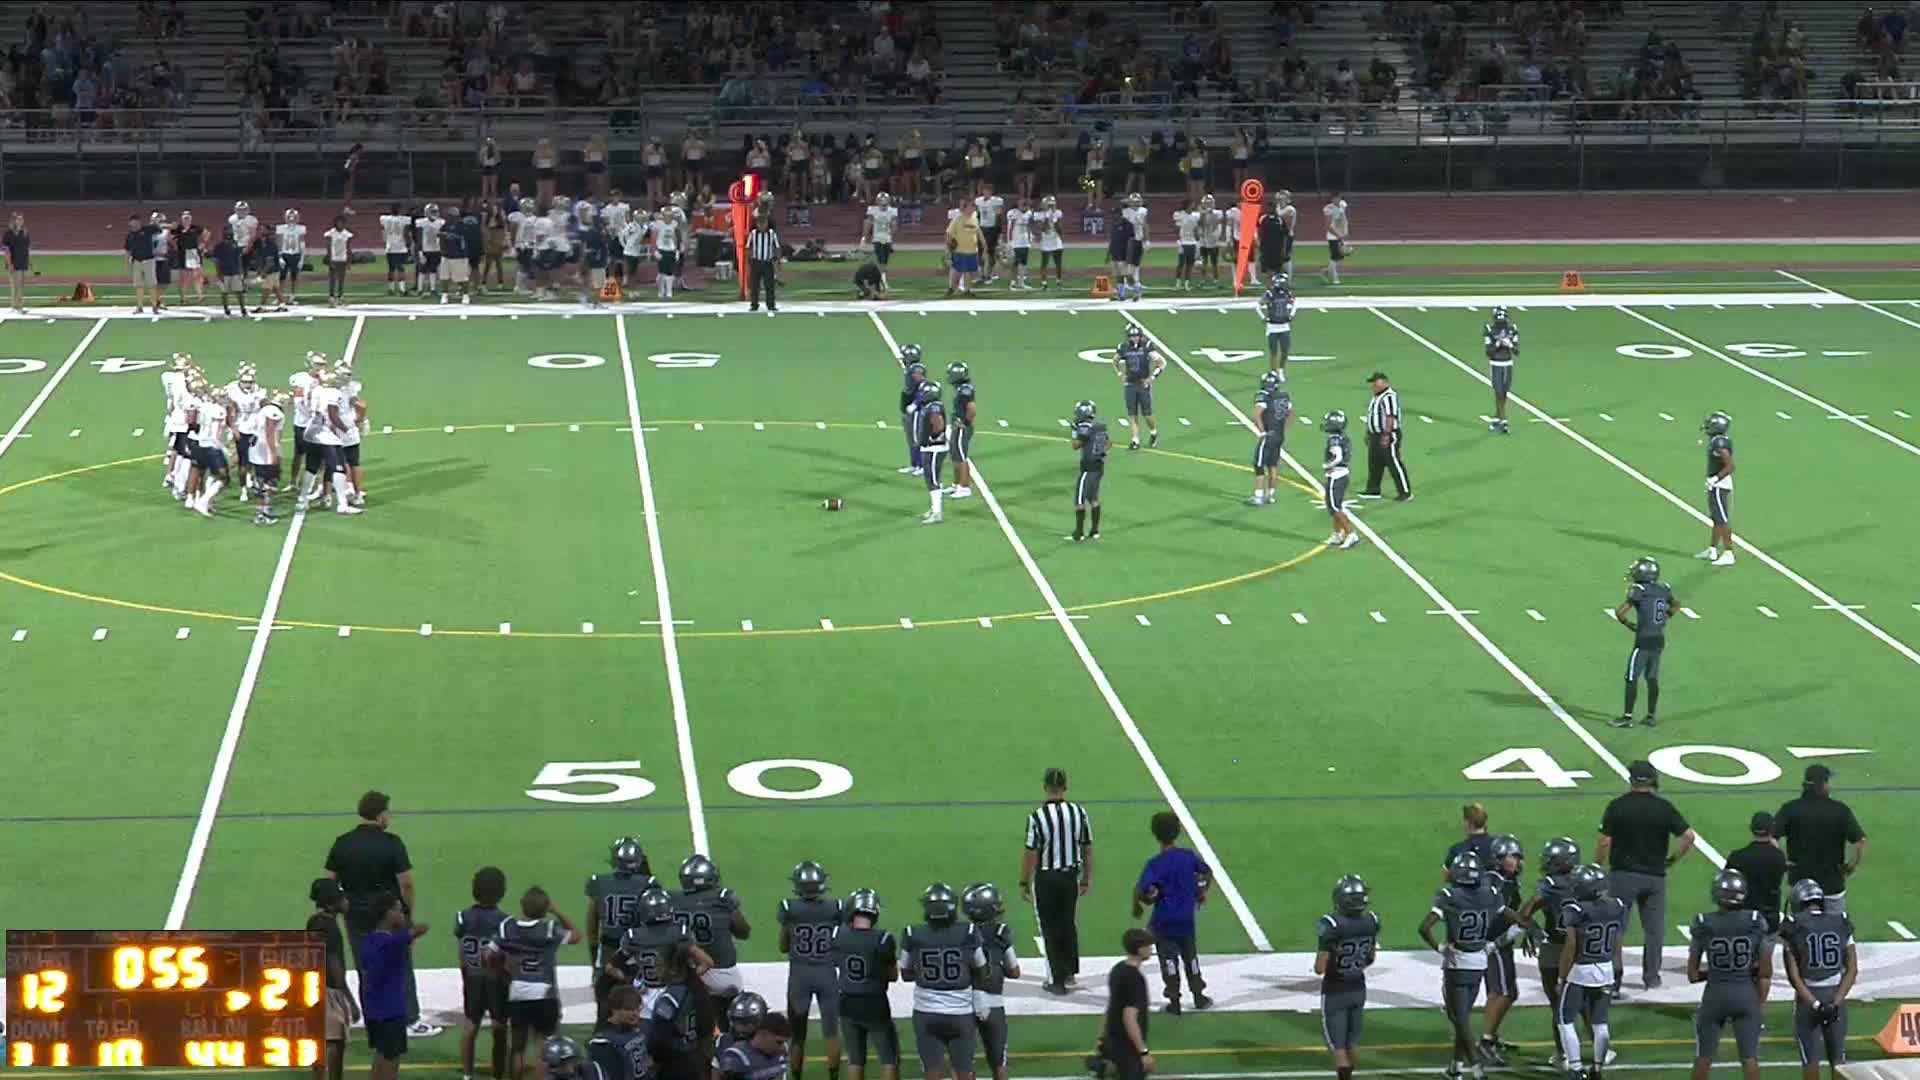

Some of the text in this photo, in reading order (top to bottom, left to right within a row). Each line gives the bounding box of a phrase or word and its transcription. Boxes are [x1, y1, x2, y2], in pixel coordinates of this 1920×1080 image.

[742, 175, 752, 197] 1
[524, 759, 855, 803] 50
[1461, 744, 1783, 788] 40
[604, 894, 639, 928] 15
[1458, 911, 1489, 943] 21
[793, 923, 836, 958] 32
[1583, 920, 1620, 957] 20
[1709, 937, 1752, 971] 28
[1805, 933, 1841, 969] 16
[846, 955, 868, 983] 9
[919, 949, 962, 984] 56
